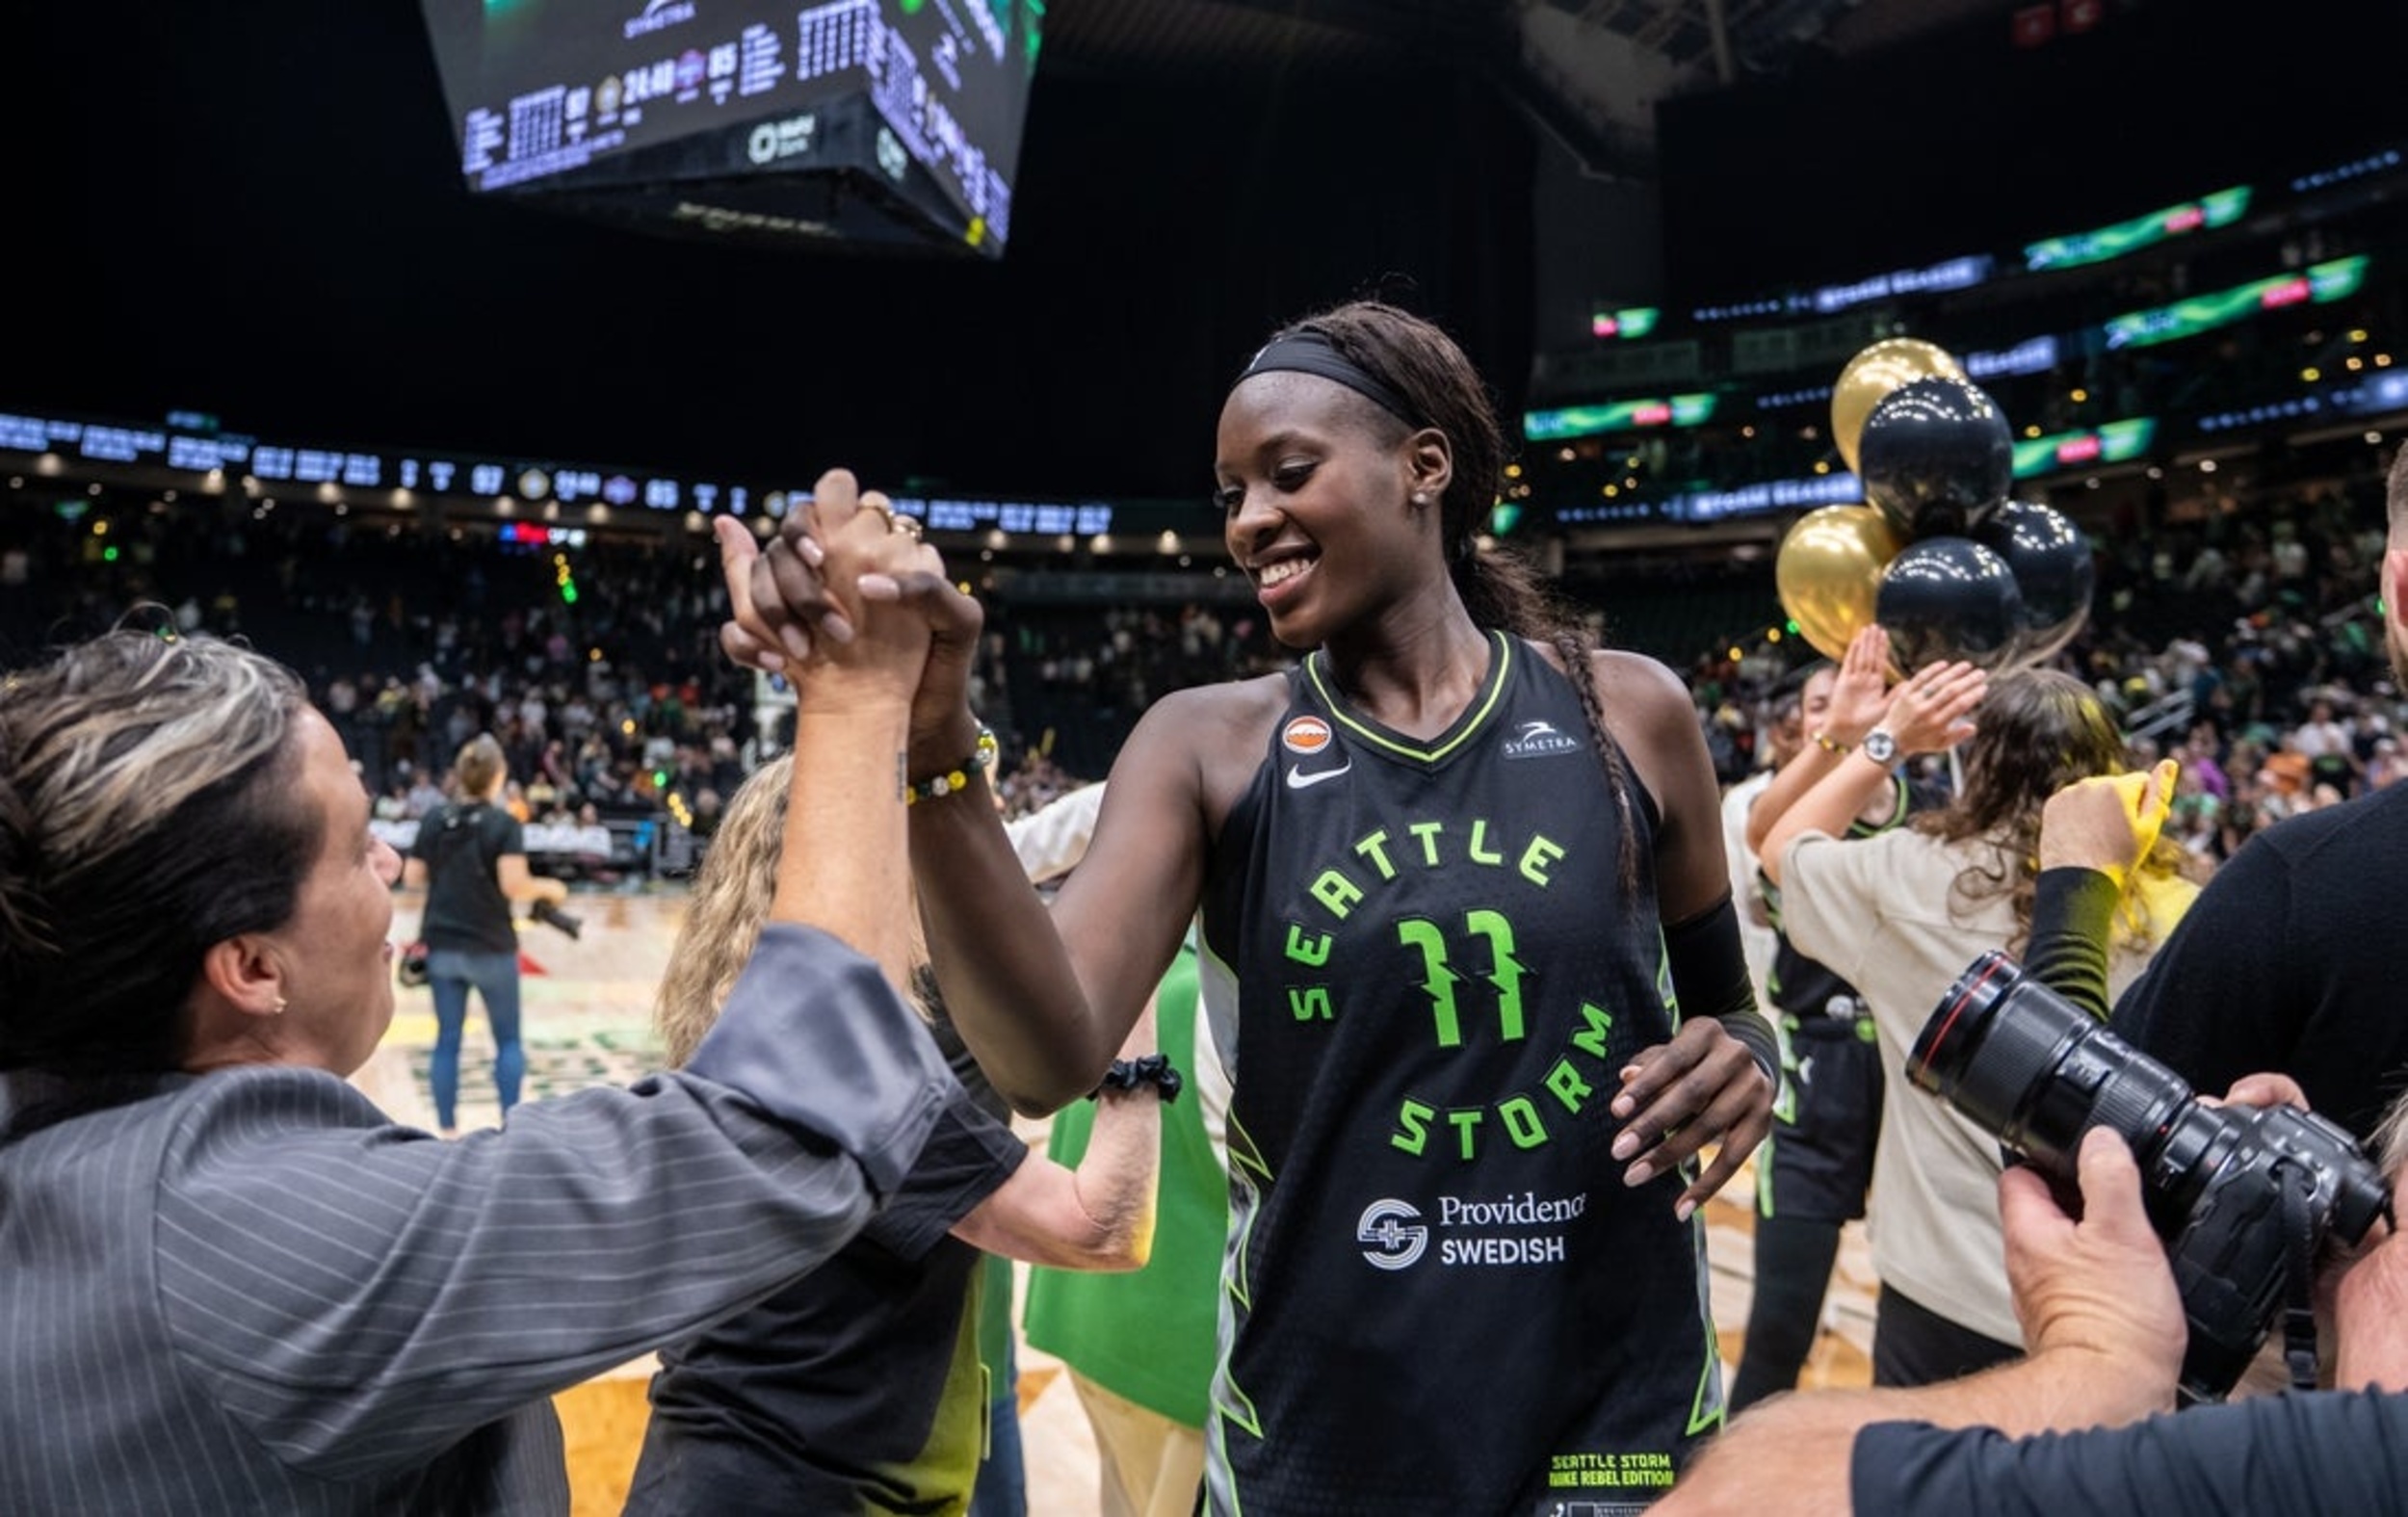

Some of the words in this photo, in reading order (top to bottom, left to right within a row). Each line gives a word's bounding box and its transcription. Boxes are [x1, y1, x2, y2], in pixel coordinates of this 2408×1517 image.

[1505, 737, 1577, 754] SYMETRA
[1286, 821, 1566, 1020] SEATTLE
[1397, 908, 1529, 1048] 11
[1390, 1001, 1613, 1162] STORM
[1441, 1237, 1565, 1266] SWEDISH
[1551, 1454, 1617, 1470] SEATTLE
[1620, 1453, 1671, 1470] STORM
[1581, 1471, 1620, 1486] REBEL
[1622, 1470, 1674, 1486] EDITION
